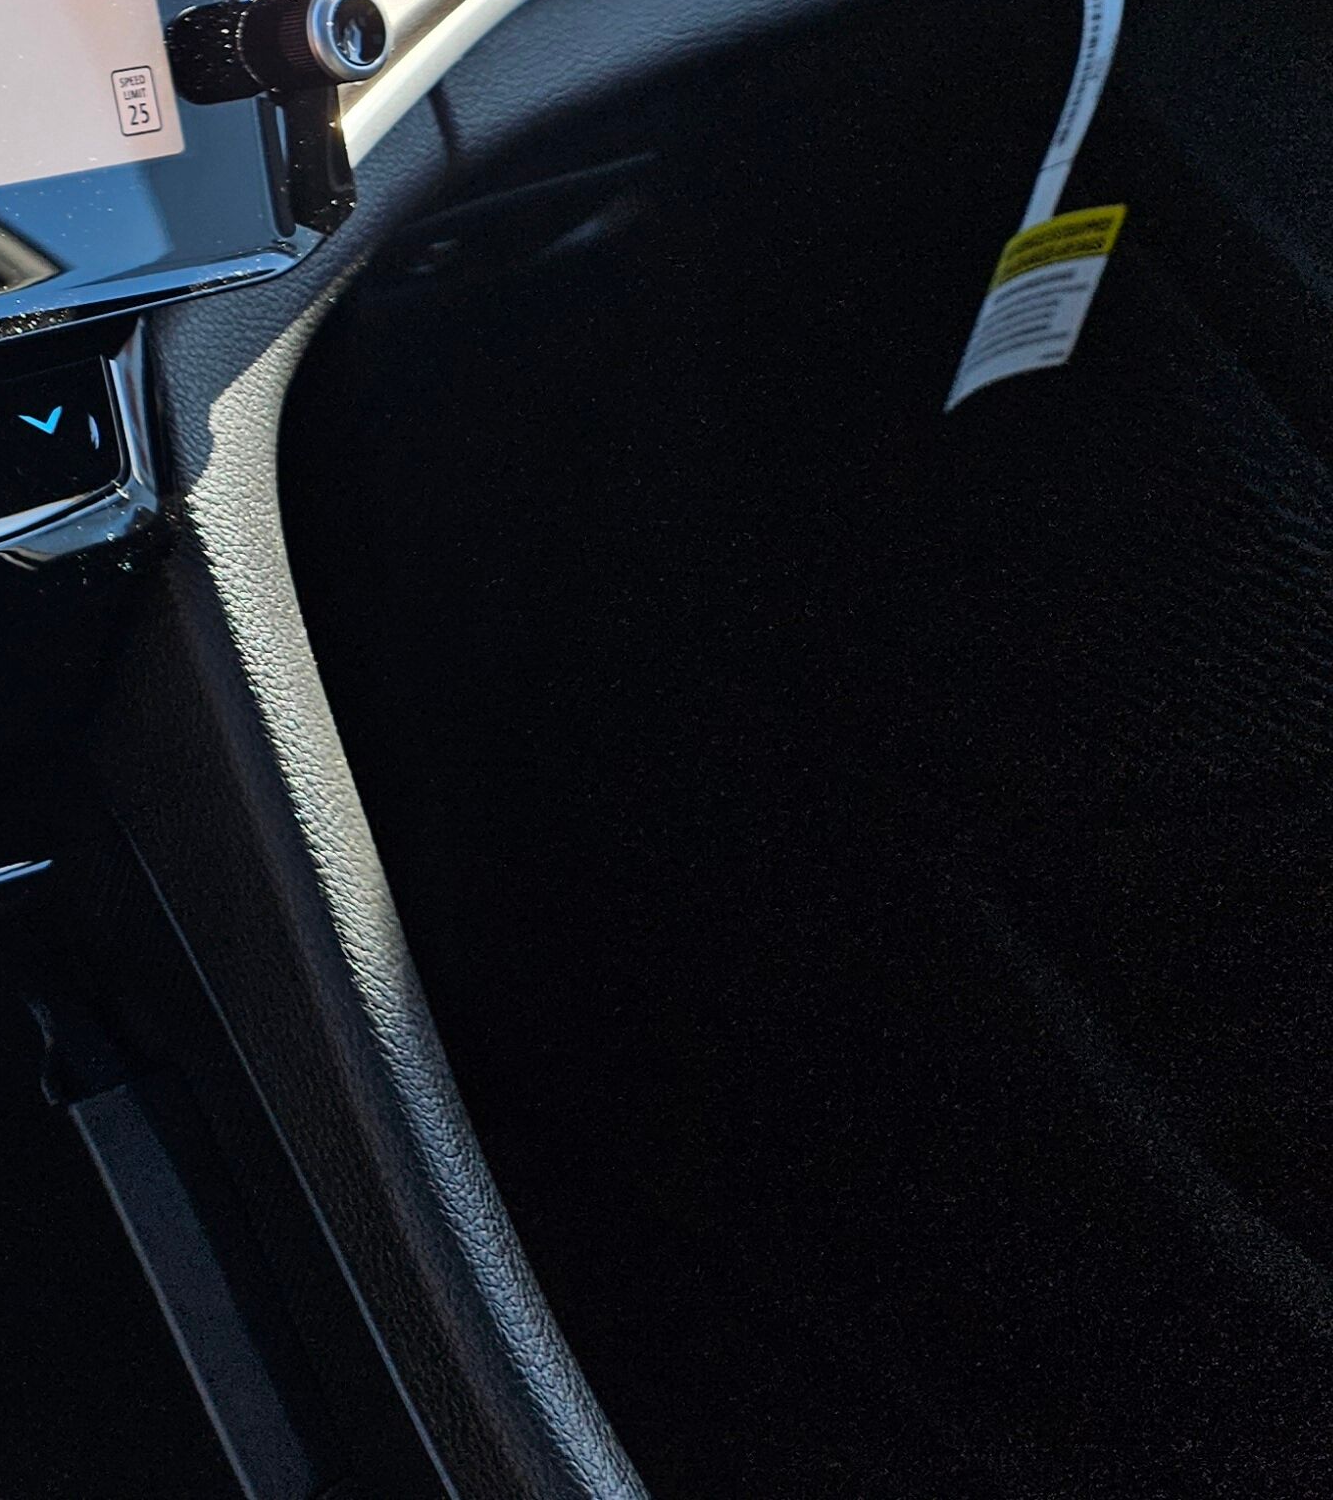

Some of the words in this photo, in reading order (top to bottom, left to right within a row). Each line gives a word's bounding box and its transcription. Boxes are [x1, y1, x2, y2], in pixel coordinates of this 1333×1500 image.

[119, 74, 146, 89] SPEED
[123, 87, 146, 100] LIMIT
[127, 102, 150, 126] 25
